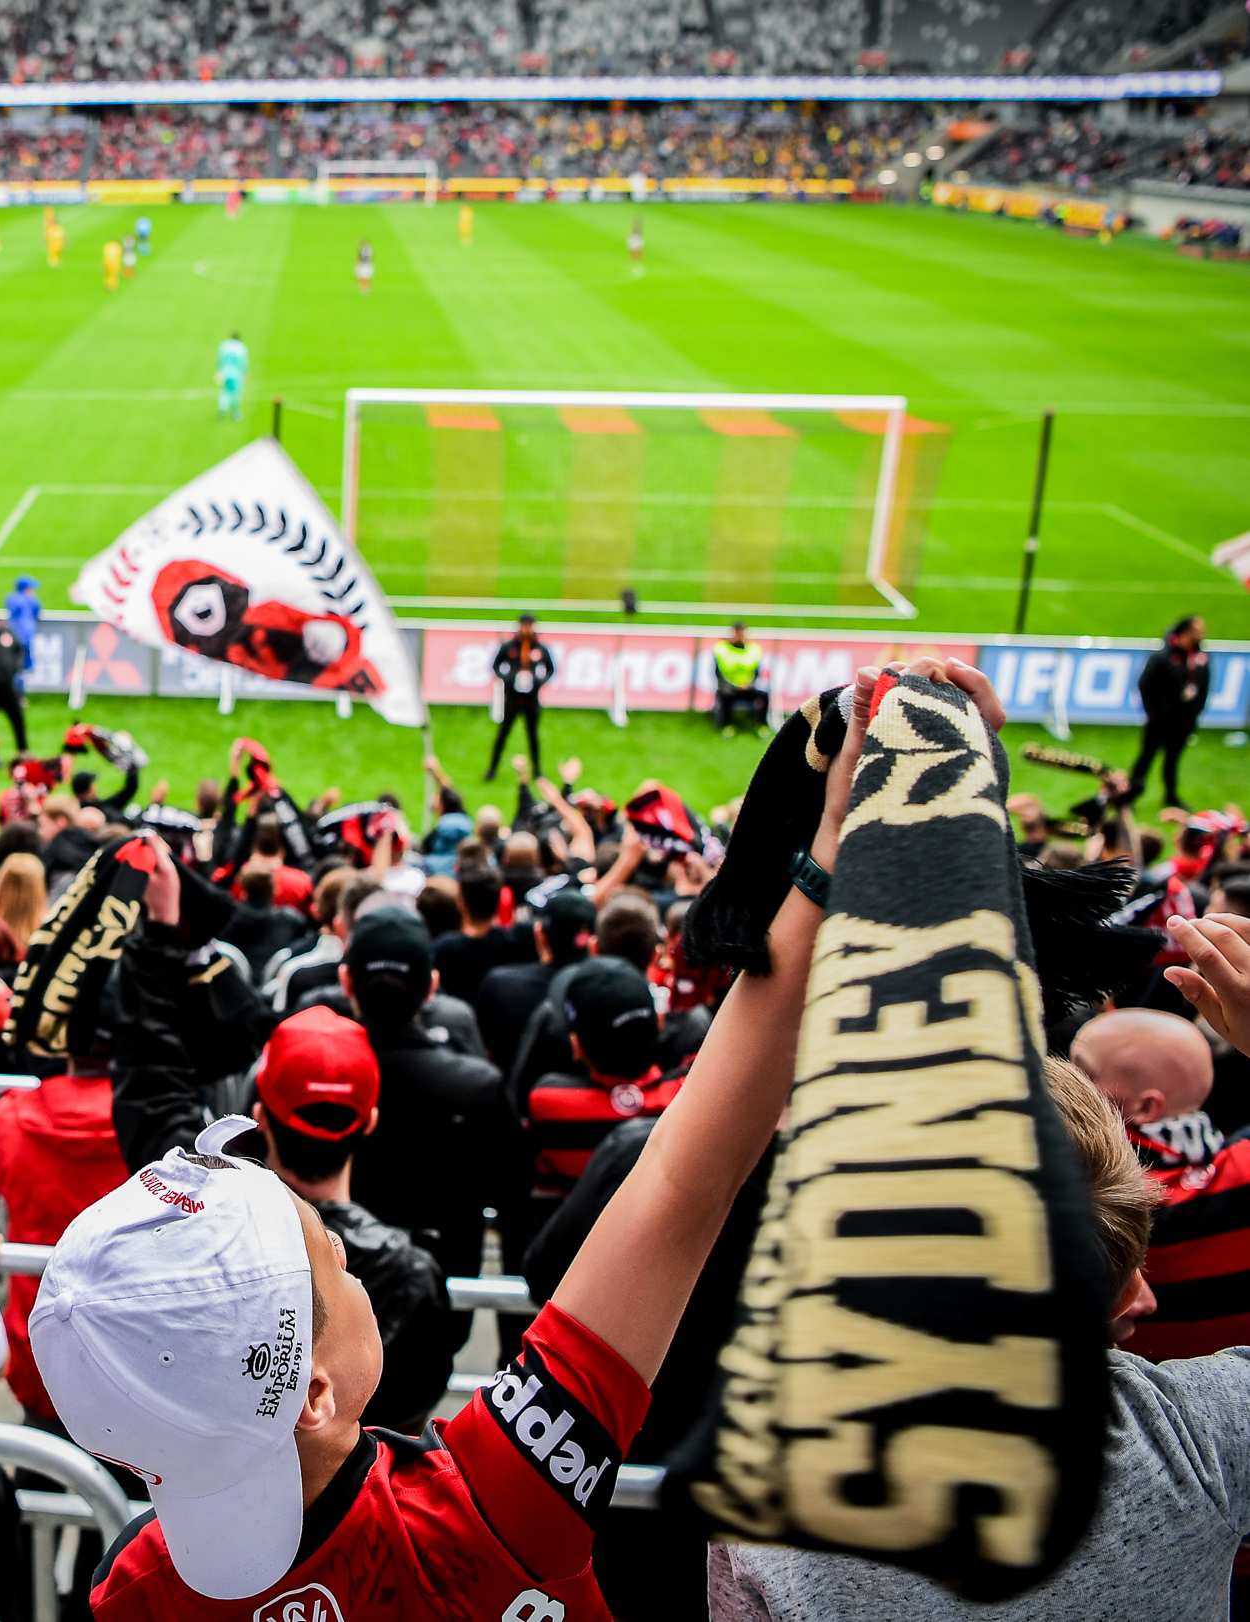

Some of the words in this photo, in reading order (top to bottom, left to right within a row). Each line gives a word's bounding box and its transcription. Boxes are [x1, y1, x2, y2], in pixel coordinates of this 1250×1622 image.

[160, 1190, 205, 1214] MEMER
[780, 908, 1062, 1568] SYDNEY
[255, 1386, 272, 1416] THE
[269, 1307, 286, 1378] COFFEE
[262, 1308, 296, 1419] EMPORIUM
